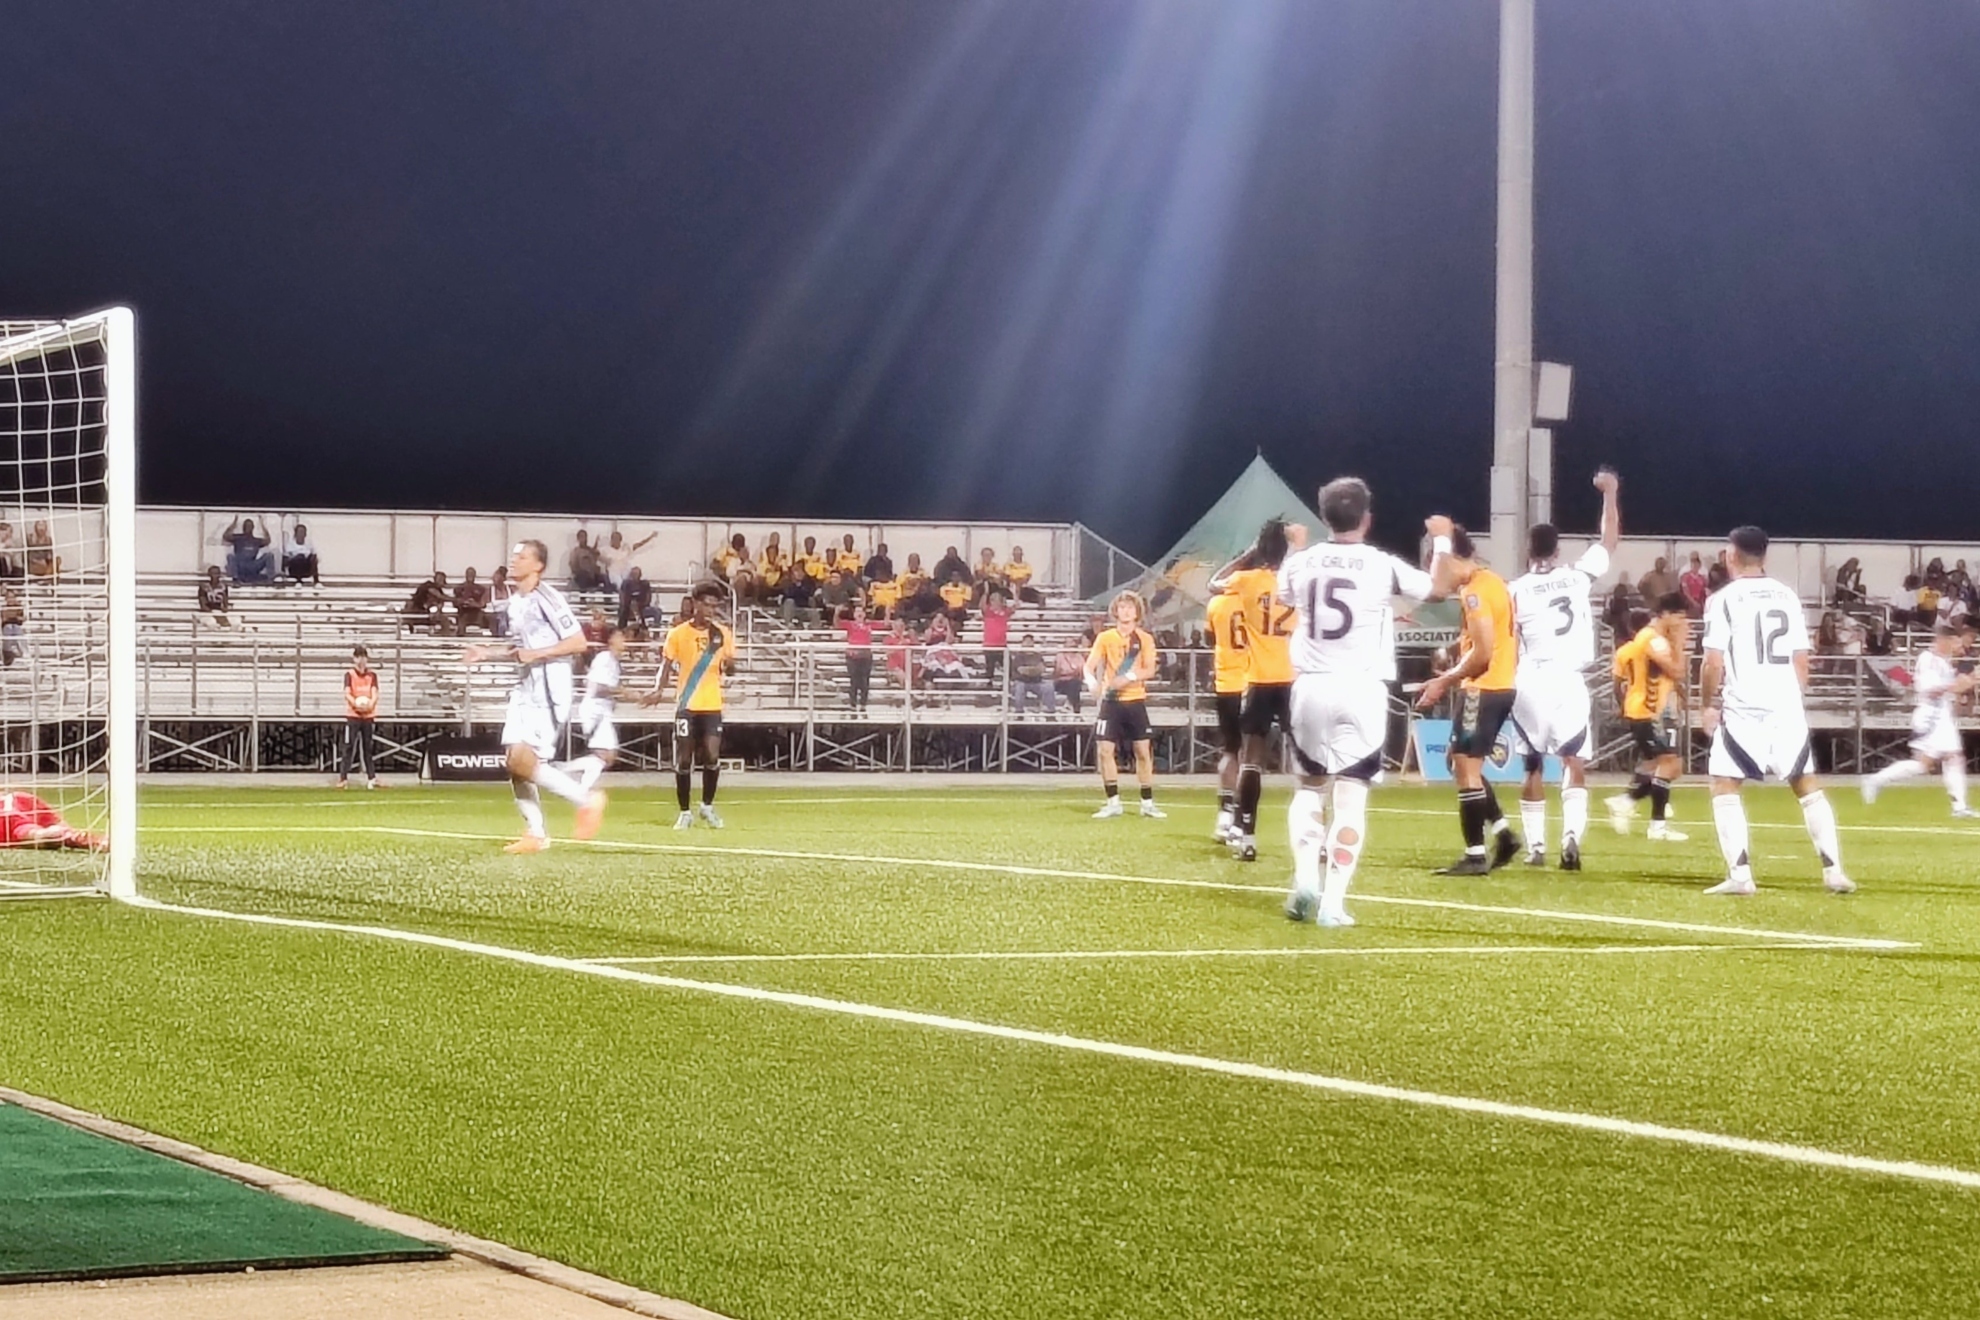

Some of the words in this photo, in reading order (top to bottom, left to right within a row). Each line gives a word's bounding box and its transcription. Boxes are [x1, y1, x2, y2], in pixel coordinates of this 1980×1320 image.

[1257, 591, 1295, 636] 12
[1307, 578, 1357, 640] 15
[1548, 596, 1574, 636] 3
[1230, 611, 1249, 650] 6
[1395, 631, 1461, 642] SSOCIATI
[1755, 609, 1789, 664] 12
[675, 718, 689, 737] 13
[1096, 720, 1107, 735] 11
[437, 754, 507, 768] POWER
